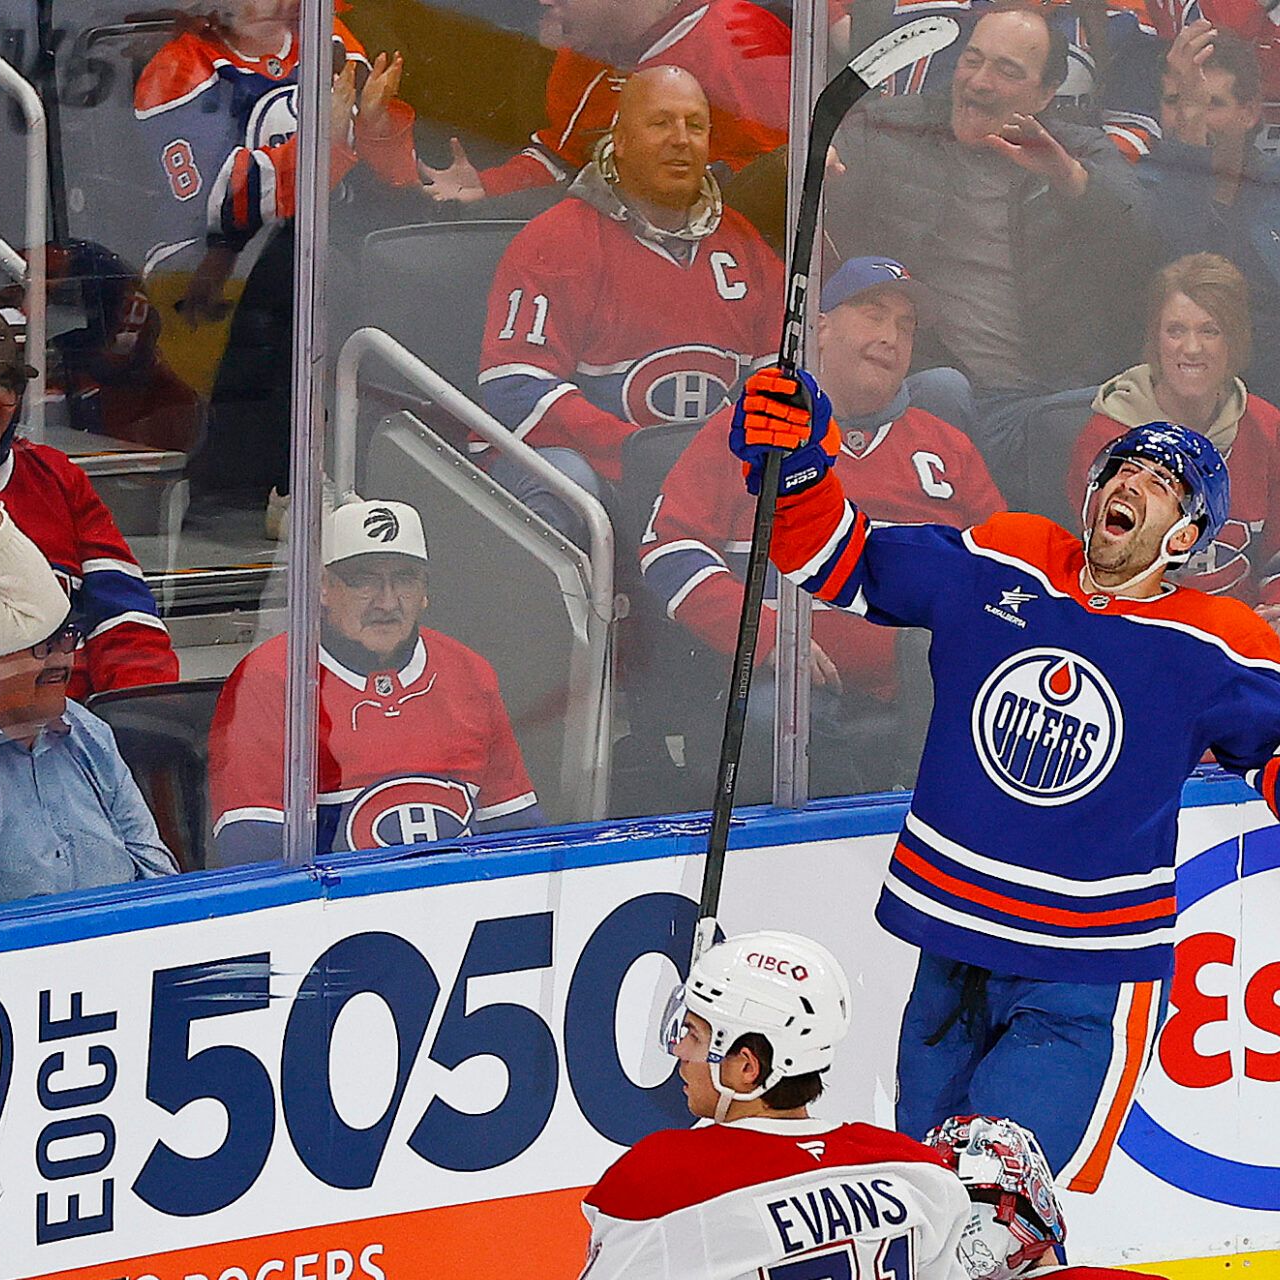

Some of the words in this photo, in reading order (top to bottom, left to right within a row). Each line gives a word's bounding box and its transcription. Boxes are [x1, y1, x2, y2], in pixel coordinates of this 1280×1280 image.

[163, 138, 204, 202] 8
[711, 252, 748, 300] C
[499, 288, 549, 346] 11
[912, 451, 953, 500] C
[992, 691, 1101, 764] OILERS
[746, 953, 791, 975] CIBC
[132, 892, 726, 1217] 5050
[36, 990, 117, 1245] EOCF
[767, 1179, 908, 1252] EVANS
